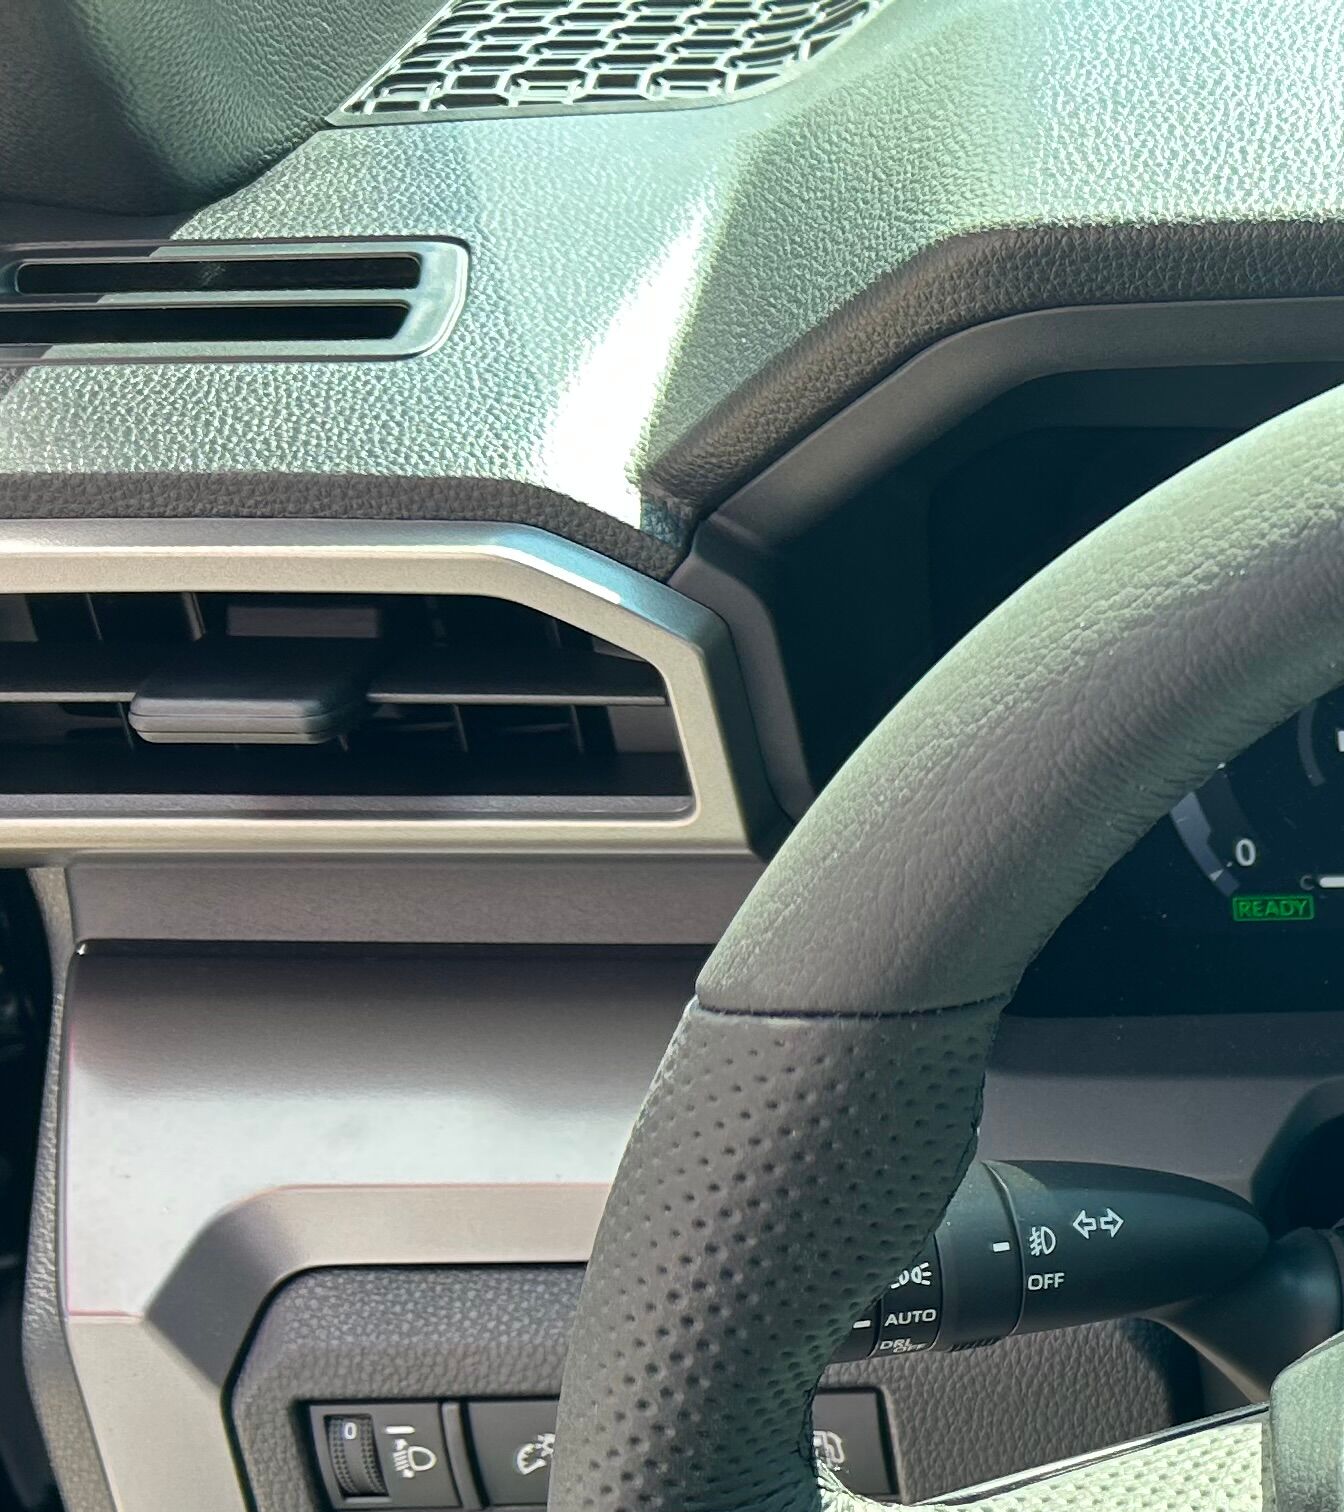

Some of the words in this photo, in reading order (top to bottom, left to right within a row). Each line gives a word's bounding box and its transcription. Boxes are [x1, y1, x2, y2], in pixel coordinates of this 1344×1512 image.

[1235, 839, 1257, 867] 0
[1300, 875, 1315, 891] C
[1237, 898, 1309, 919] READY
[1027, 1271, 1066, 1291] OFF
[884, 1308, 937, 1327] AUTO
[880, 1337, 912, 1350] DRL
[343, 1421, 357, 1440] 0
